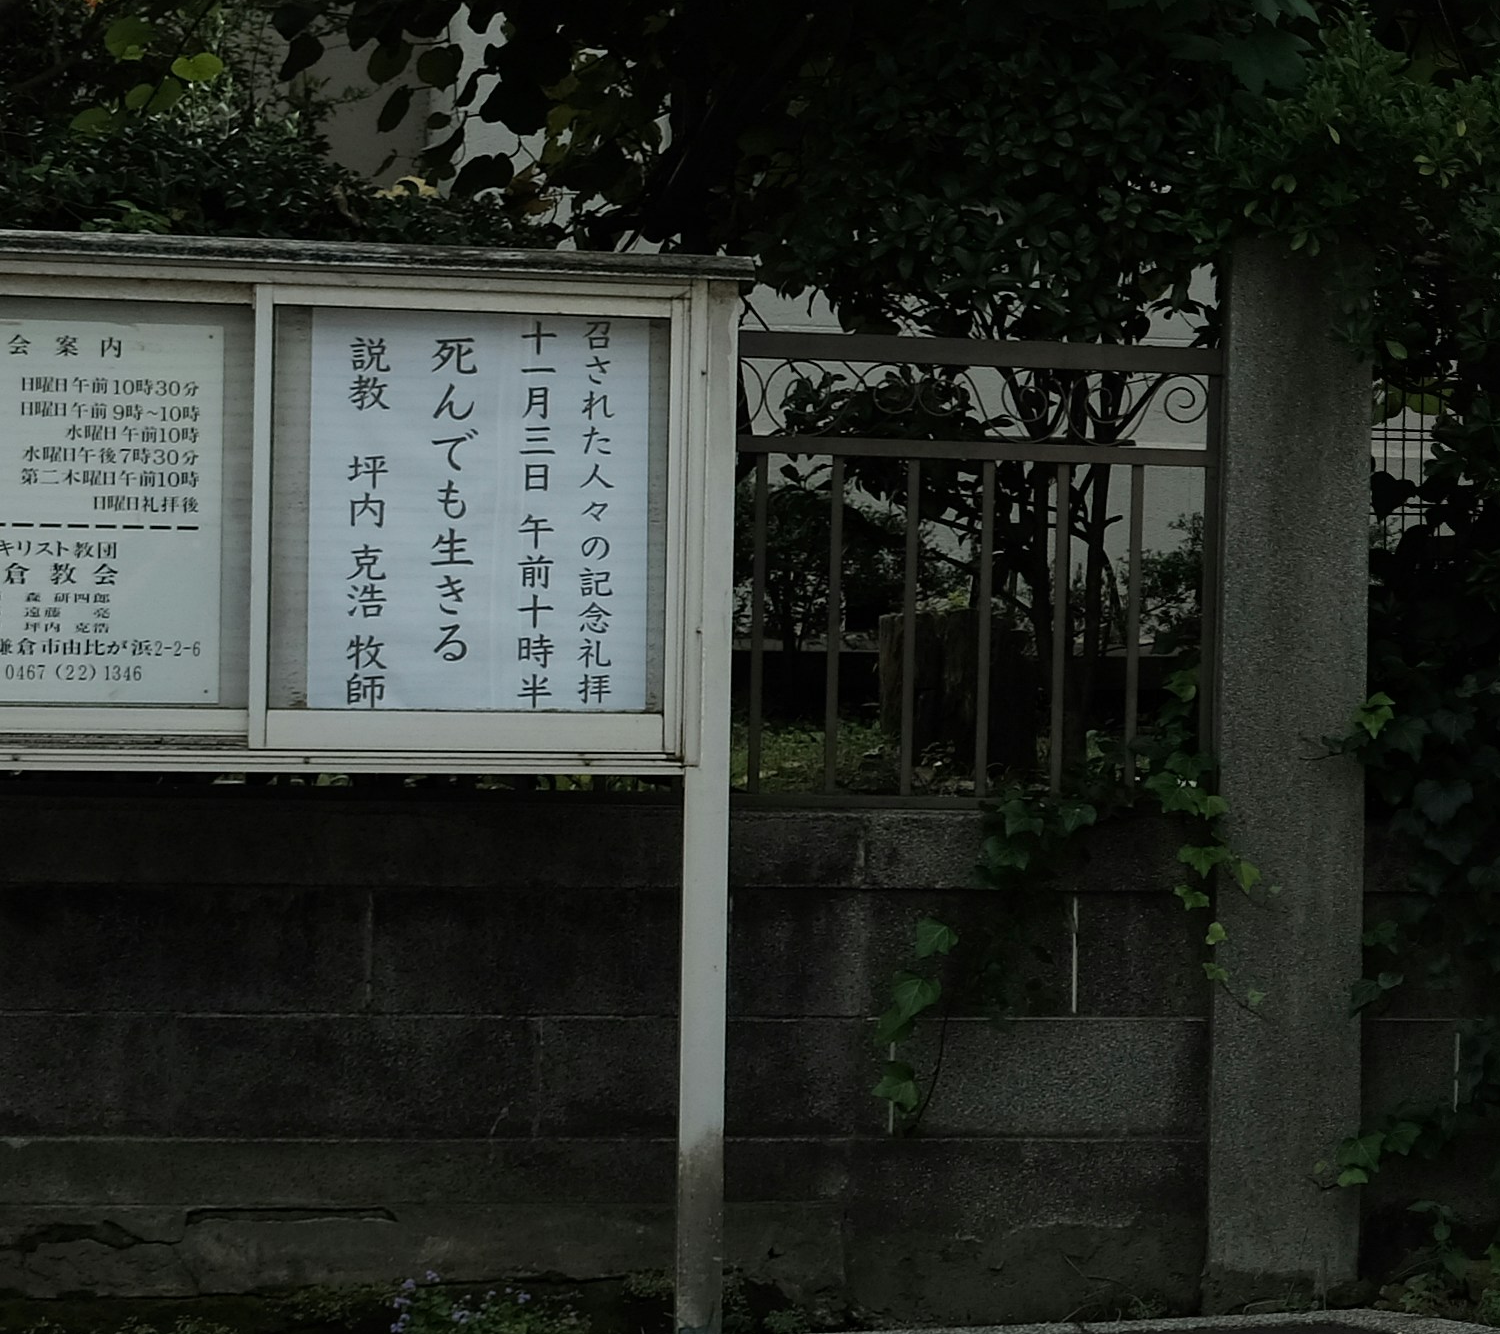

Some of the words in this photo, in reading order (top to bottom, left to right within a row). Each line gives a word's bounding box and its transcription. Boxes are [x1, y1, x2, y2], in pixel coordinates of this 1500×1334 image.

[348, 336, 391, 412] 説教
[21, 468, 199, 488] 第二木曜日午前10時
[22, 445, 199, 465] 水曜日午後7時30分
[93, 495, 199, 513] 日曜日礼拝後
[430, 336, 477, 663] 死んでも生きる
[576, 321, 614, 705] 召された人々の記念礼拝
[345, 635, 388, 709] 牧師
